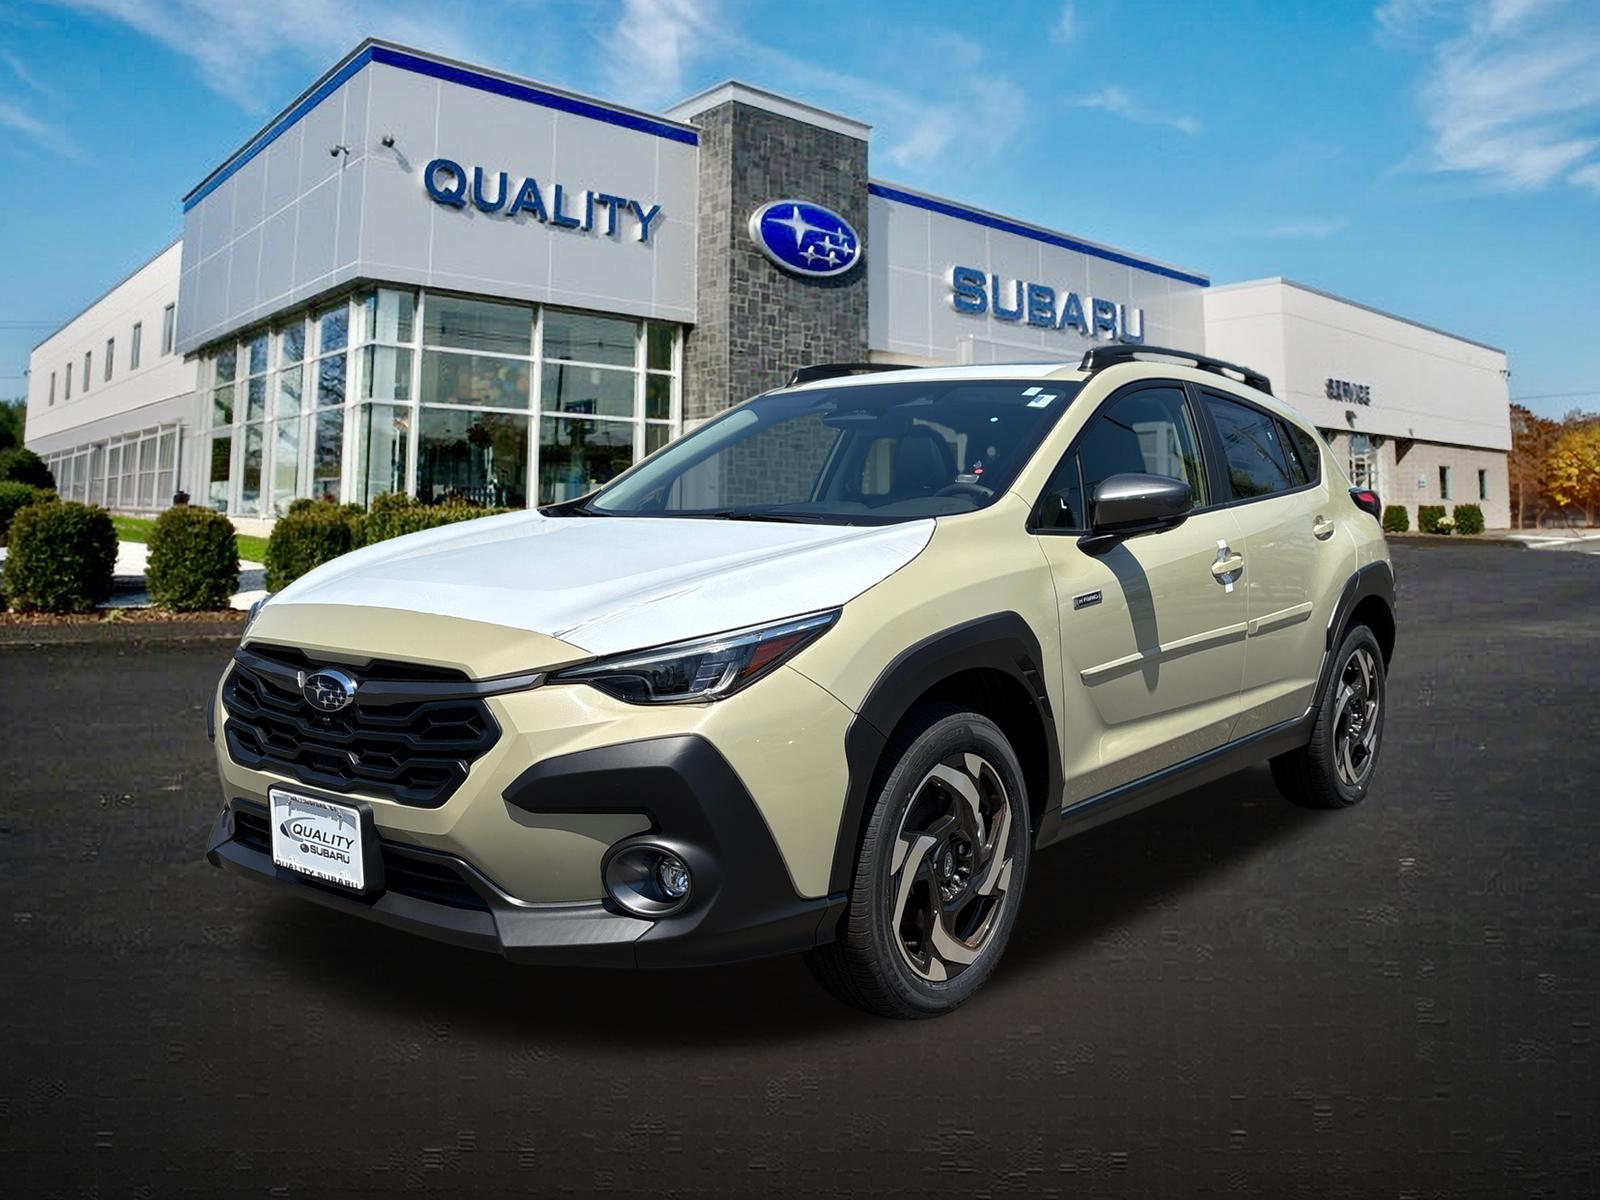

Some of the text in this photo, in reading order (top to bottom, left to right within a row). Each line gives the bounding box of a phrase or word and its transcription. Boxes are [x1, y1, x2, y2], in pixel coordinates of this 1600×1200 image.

[424, 159, 661, 242] QUALITY
[951, 265, 1144, 344] SUBARU
[1325, 378, 1371, 407] SERVICE
[292, 823, 355, 850] QUALITY
[310, 845, 350, 864] SUBARU
[275, 858, 359, 889] QUALITY SUBARU
